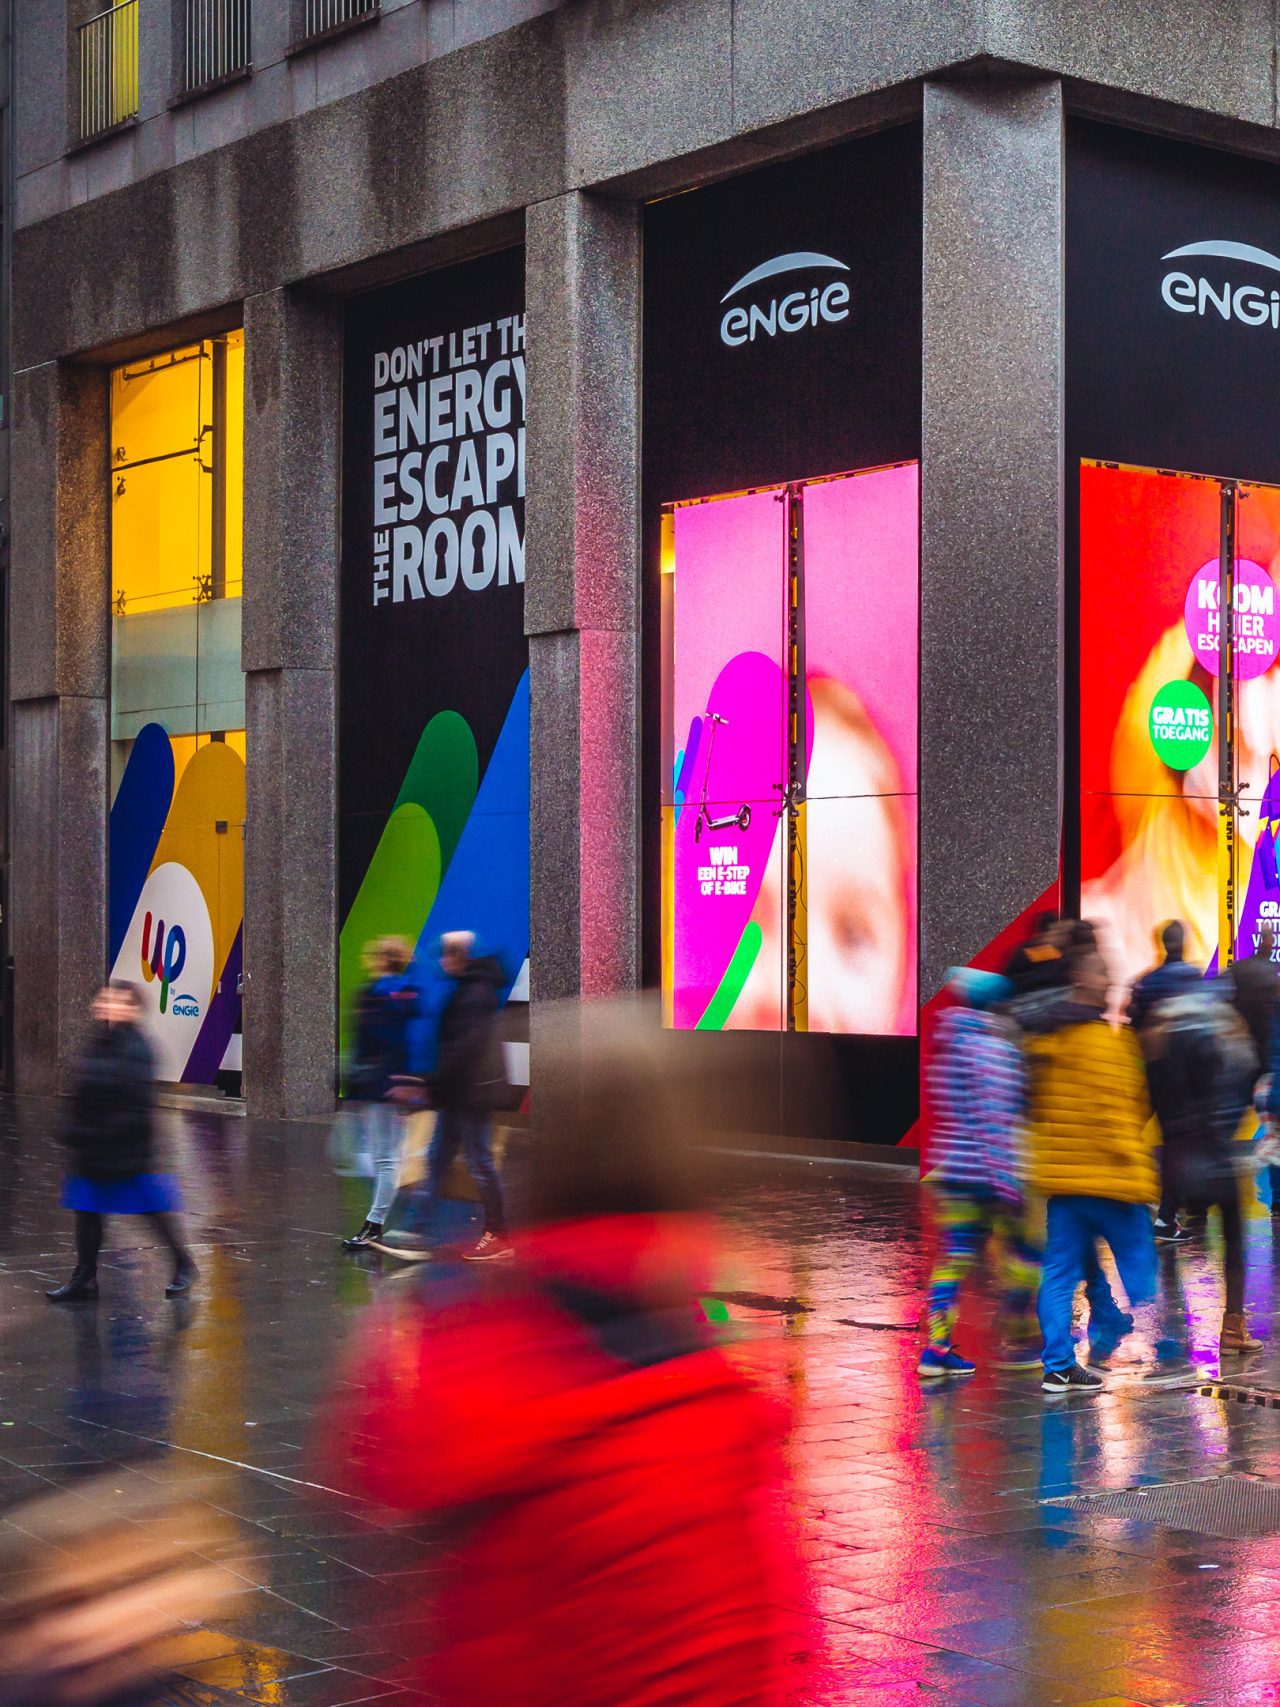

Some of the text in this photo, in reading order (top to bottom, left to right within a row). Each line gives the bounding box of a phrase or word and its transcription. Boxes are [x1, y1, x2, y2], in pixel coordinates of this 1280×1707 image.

[374, 312, 526, 389] DON'T LET TH
[373, 427, 526, 527] ESCAP
[373, 528, 390, 607] THE
[1152, 706, 1210, 727] GRATIS
[1152, 725, 1209, 742] TOEGANG
[709, 846, 739, 866] WIN
[697, 865, 751, 881] EEN E-STEP
[700, 880, 747, 896] OF E-BIKE
